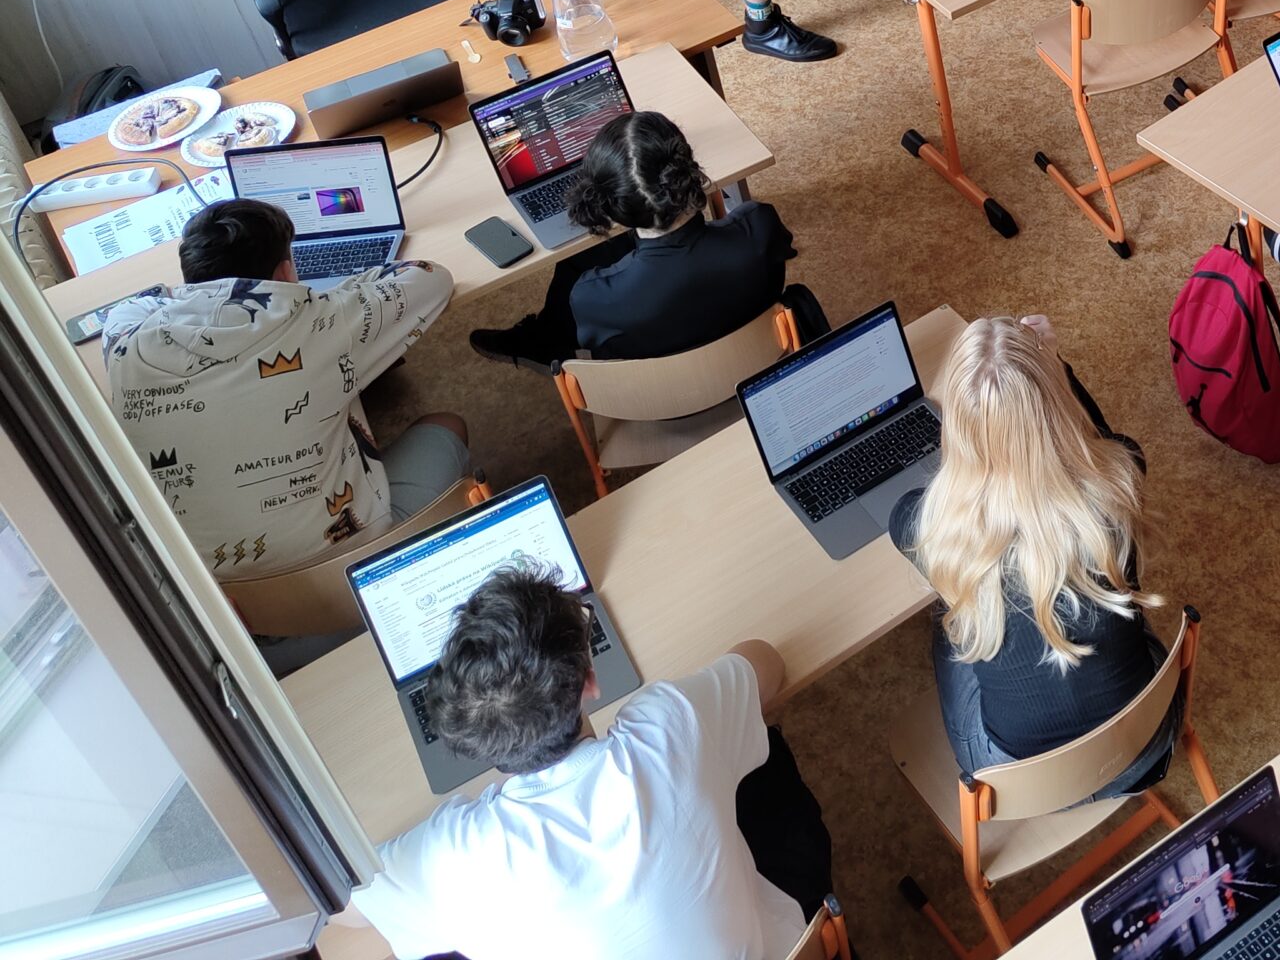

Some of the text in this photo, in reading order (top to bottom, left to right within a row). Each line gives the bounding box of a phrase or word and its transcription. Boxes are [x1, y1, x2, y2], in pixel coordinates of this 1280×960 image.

[123, 398, 155, 411] ASKEW
[235, 454, 292, 474] AMATEUR
[264, 496, 287, 509] NEW
